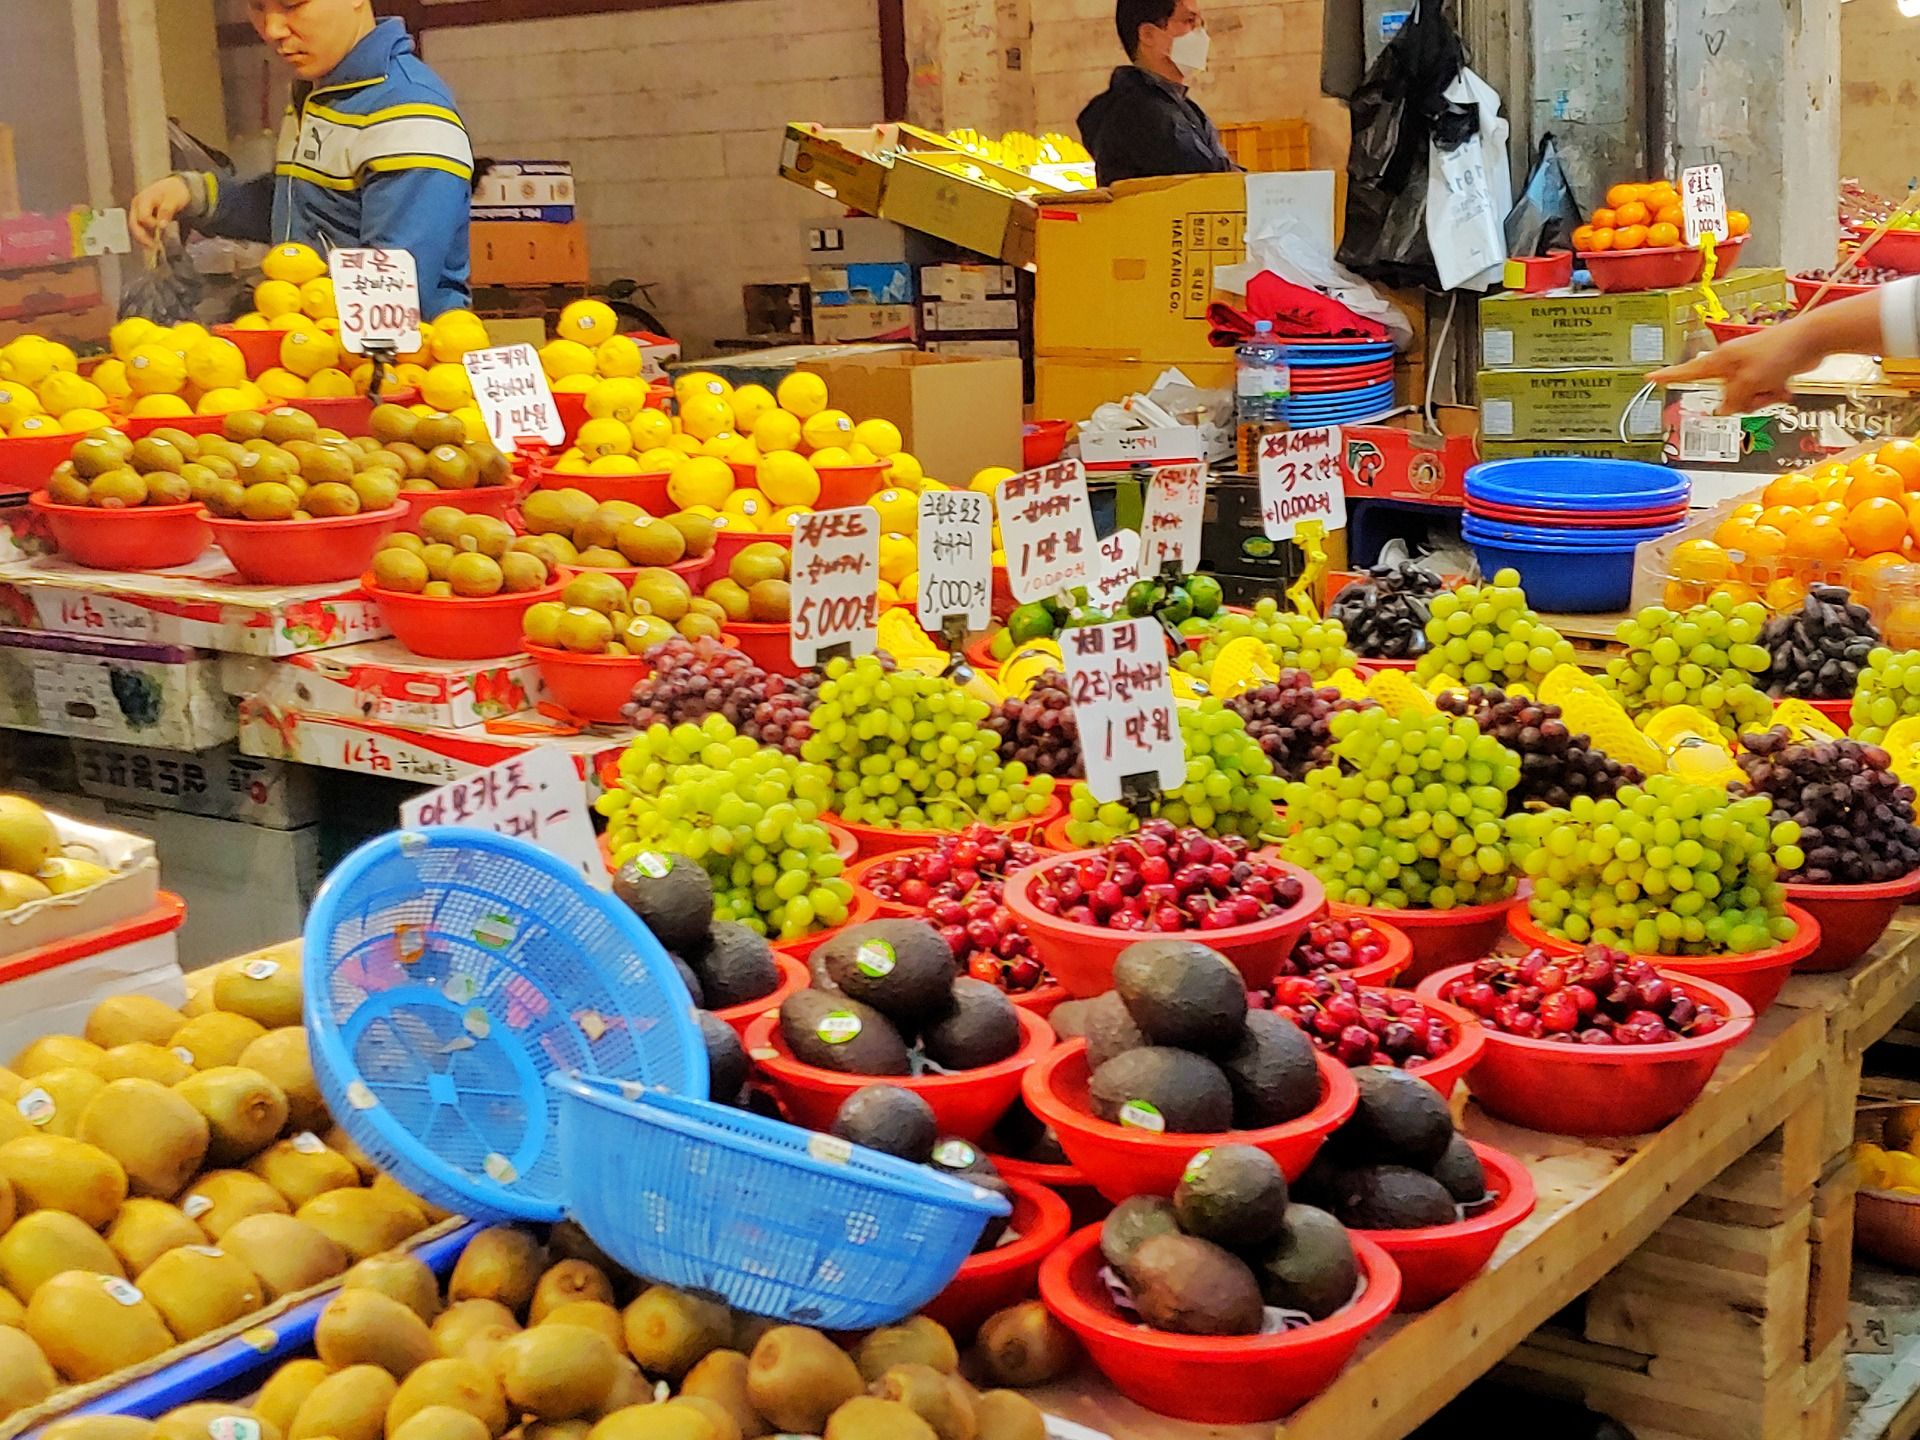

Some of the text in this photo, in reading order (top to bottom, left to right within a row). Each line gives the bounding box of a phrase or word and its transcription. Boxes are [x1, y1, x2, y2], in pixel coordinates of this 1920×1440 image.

[1170, 219, 1183, 288] HAEYANG
[1531, 305, 1612, 317] HAPPY VALLEY
[1552, 318, 1593, 328] FRUITS
[1531, 377, 1612, 388] HAPPY VALLEY
[1552, 389, 1592, 399] FRUITS
[1775, 403, 1900, 435] Sunkist
[1071, 623, 1137, 655] 체리
[1126, 707, 1172, 752] 만원
